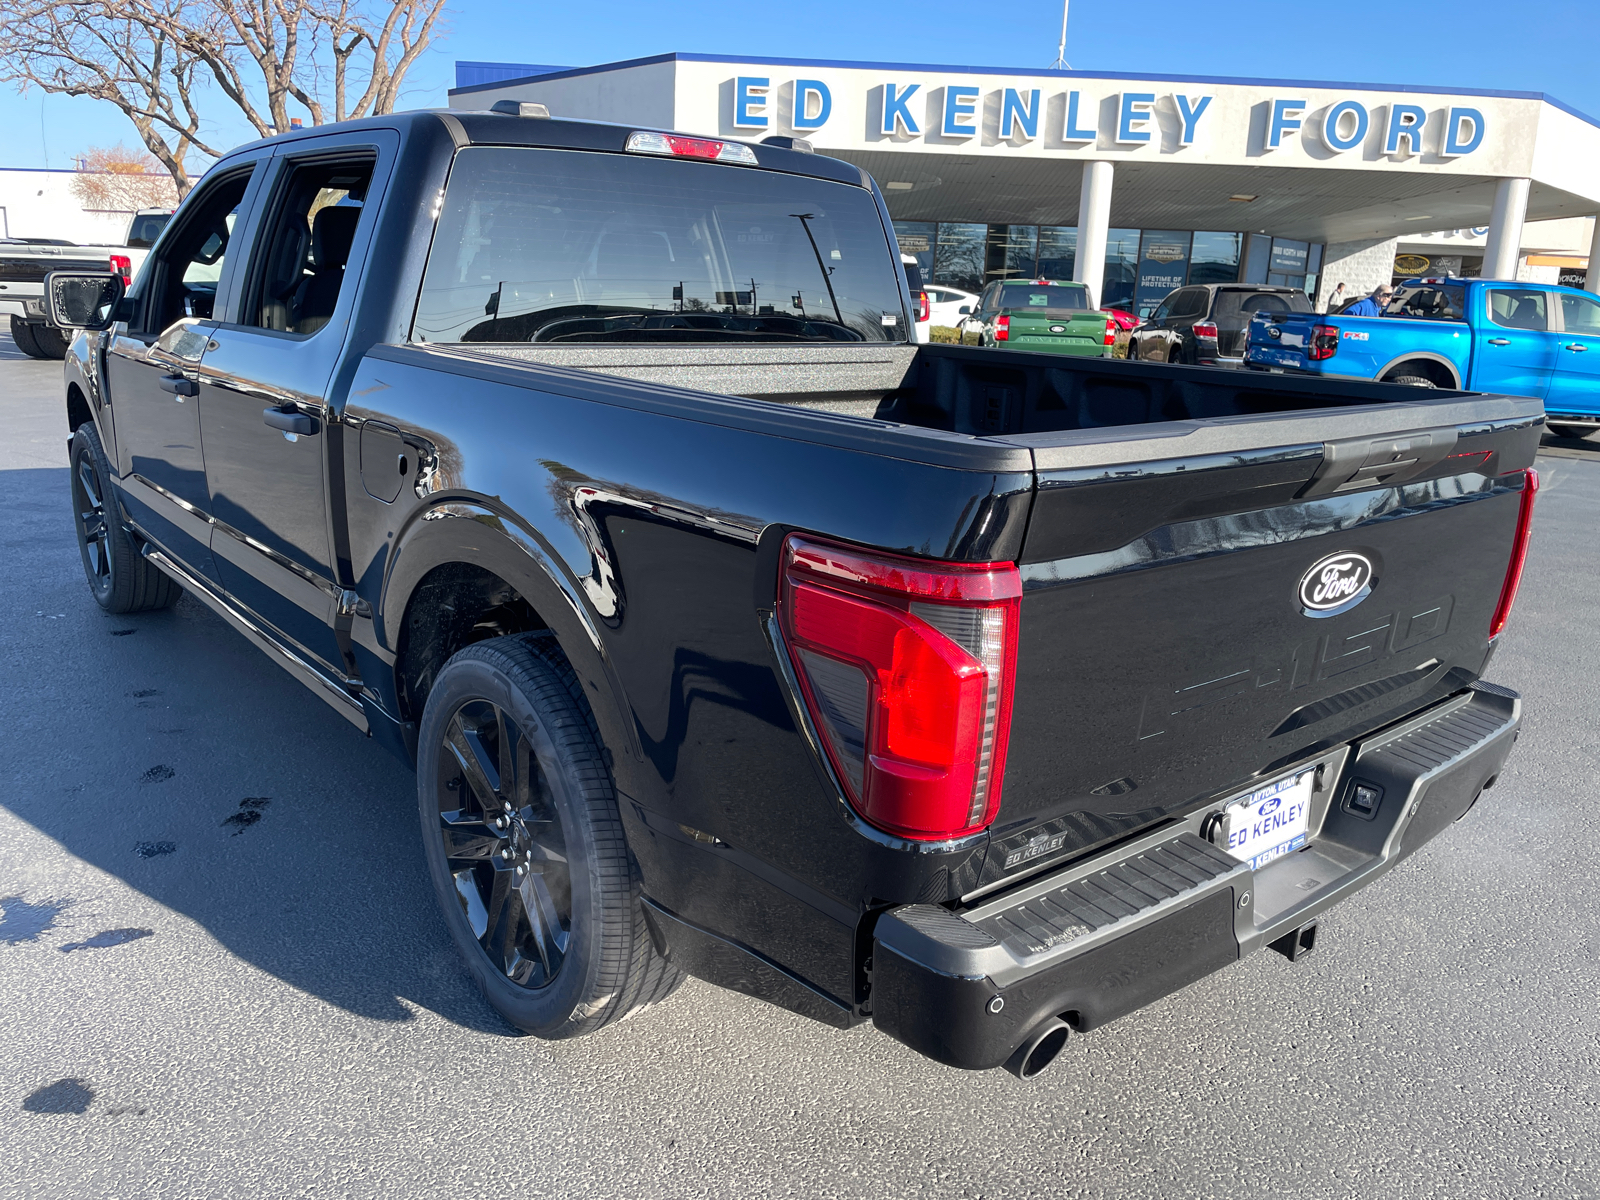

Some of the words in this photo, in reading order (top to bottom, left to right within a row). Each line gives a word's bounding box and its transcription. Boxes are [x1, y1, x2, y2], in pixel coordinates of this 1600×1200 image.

[734, 76, 832, 130] ED
[882, 82, 1216, 147] KENLEY
[1264, 97, 1488, 157] FORD
[1559, 274, 1586, 284] YOKOHA
[1020, 336, 1092, 345] MAVERICK
[1343, 331, 1370, 341] FX4
[1313, 561, 1362, 602] Ford
[1138, 595, 1456, 741] F-150
[1278, 775, 1296, 791] UTAH
[1229, 828, 1247, 849] ED
[1252, 801, 1305, 839] KENLEY
[1006, 852, 1022, 865] ED
[1024, 835, 1066, 858] KENLEY
[1255, 840, 1291, 867] KENLEY
